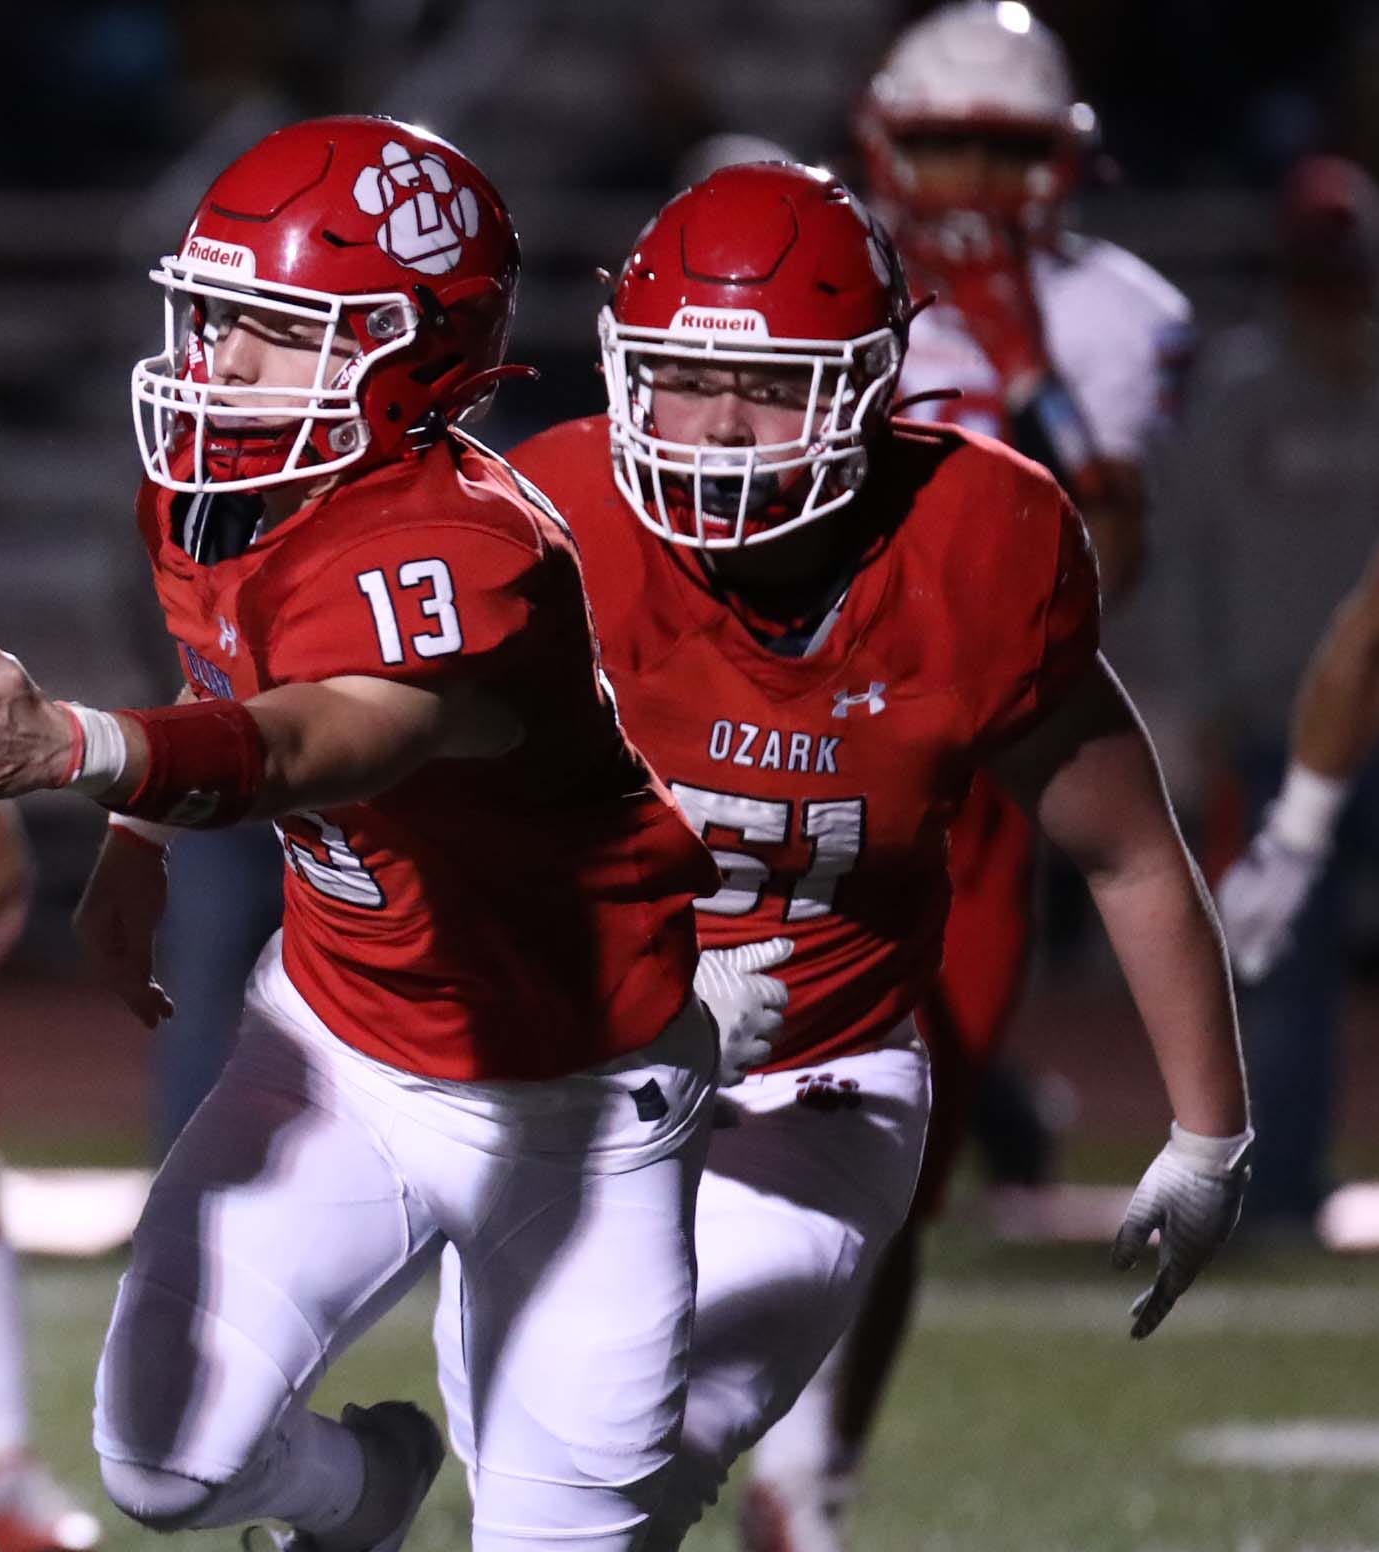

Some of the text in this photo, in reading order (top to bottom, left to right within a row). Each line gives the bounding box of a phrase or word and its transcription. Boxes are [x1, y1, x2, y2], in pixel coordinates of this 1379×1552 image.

[187, 241, 244, 268] Riddell
[681, 313, 756, 331] Riddell
[356, 557, 463, 664] 13
[708, 719, 841, 774] OZARK
